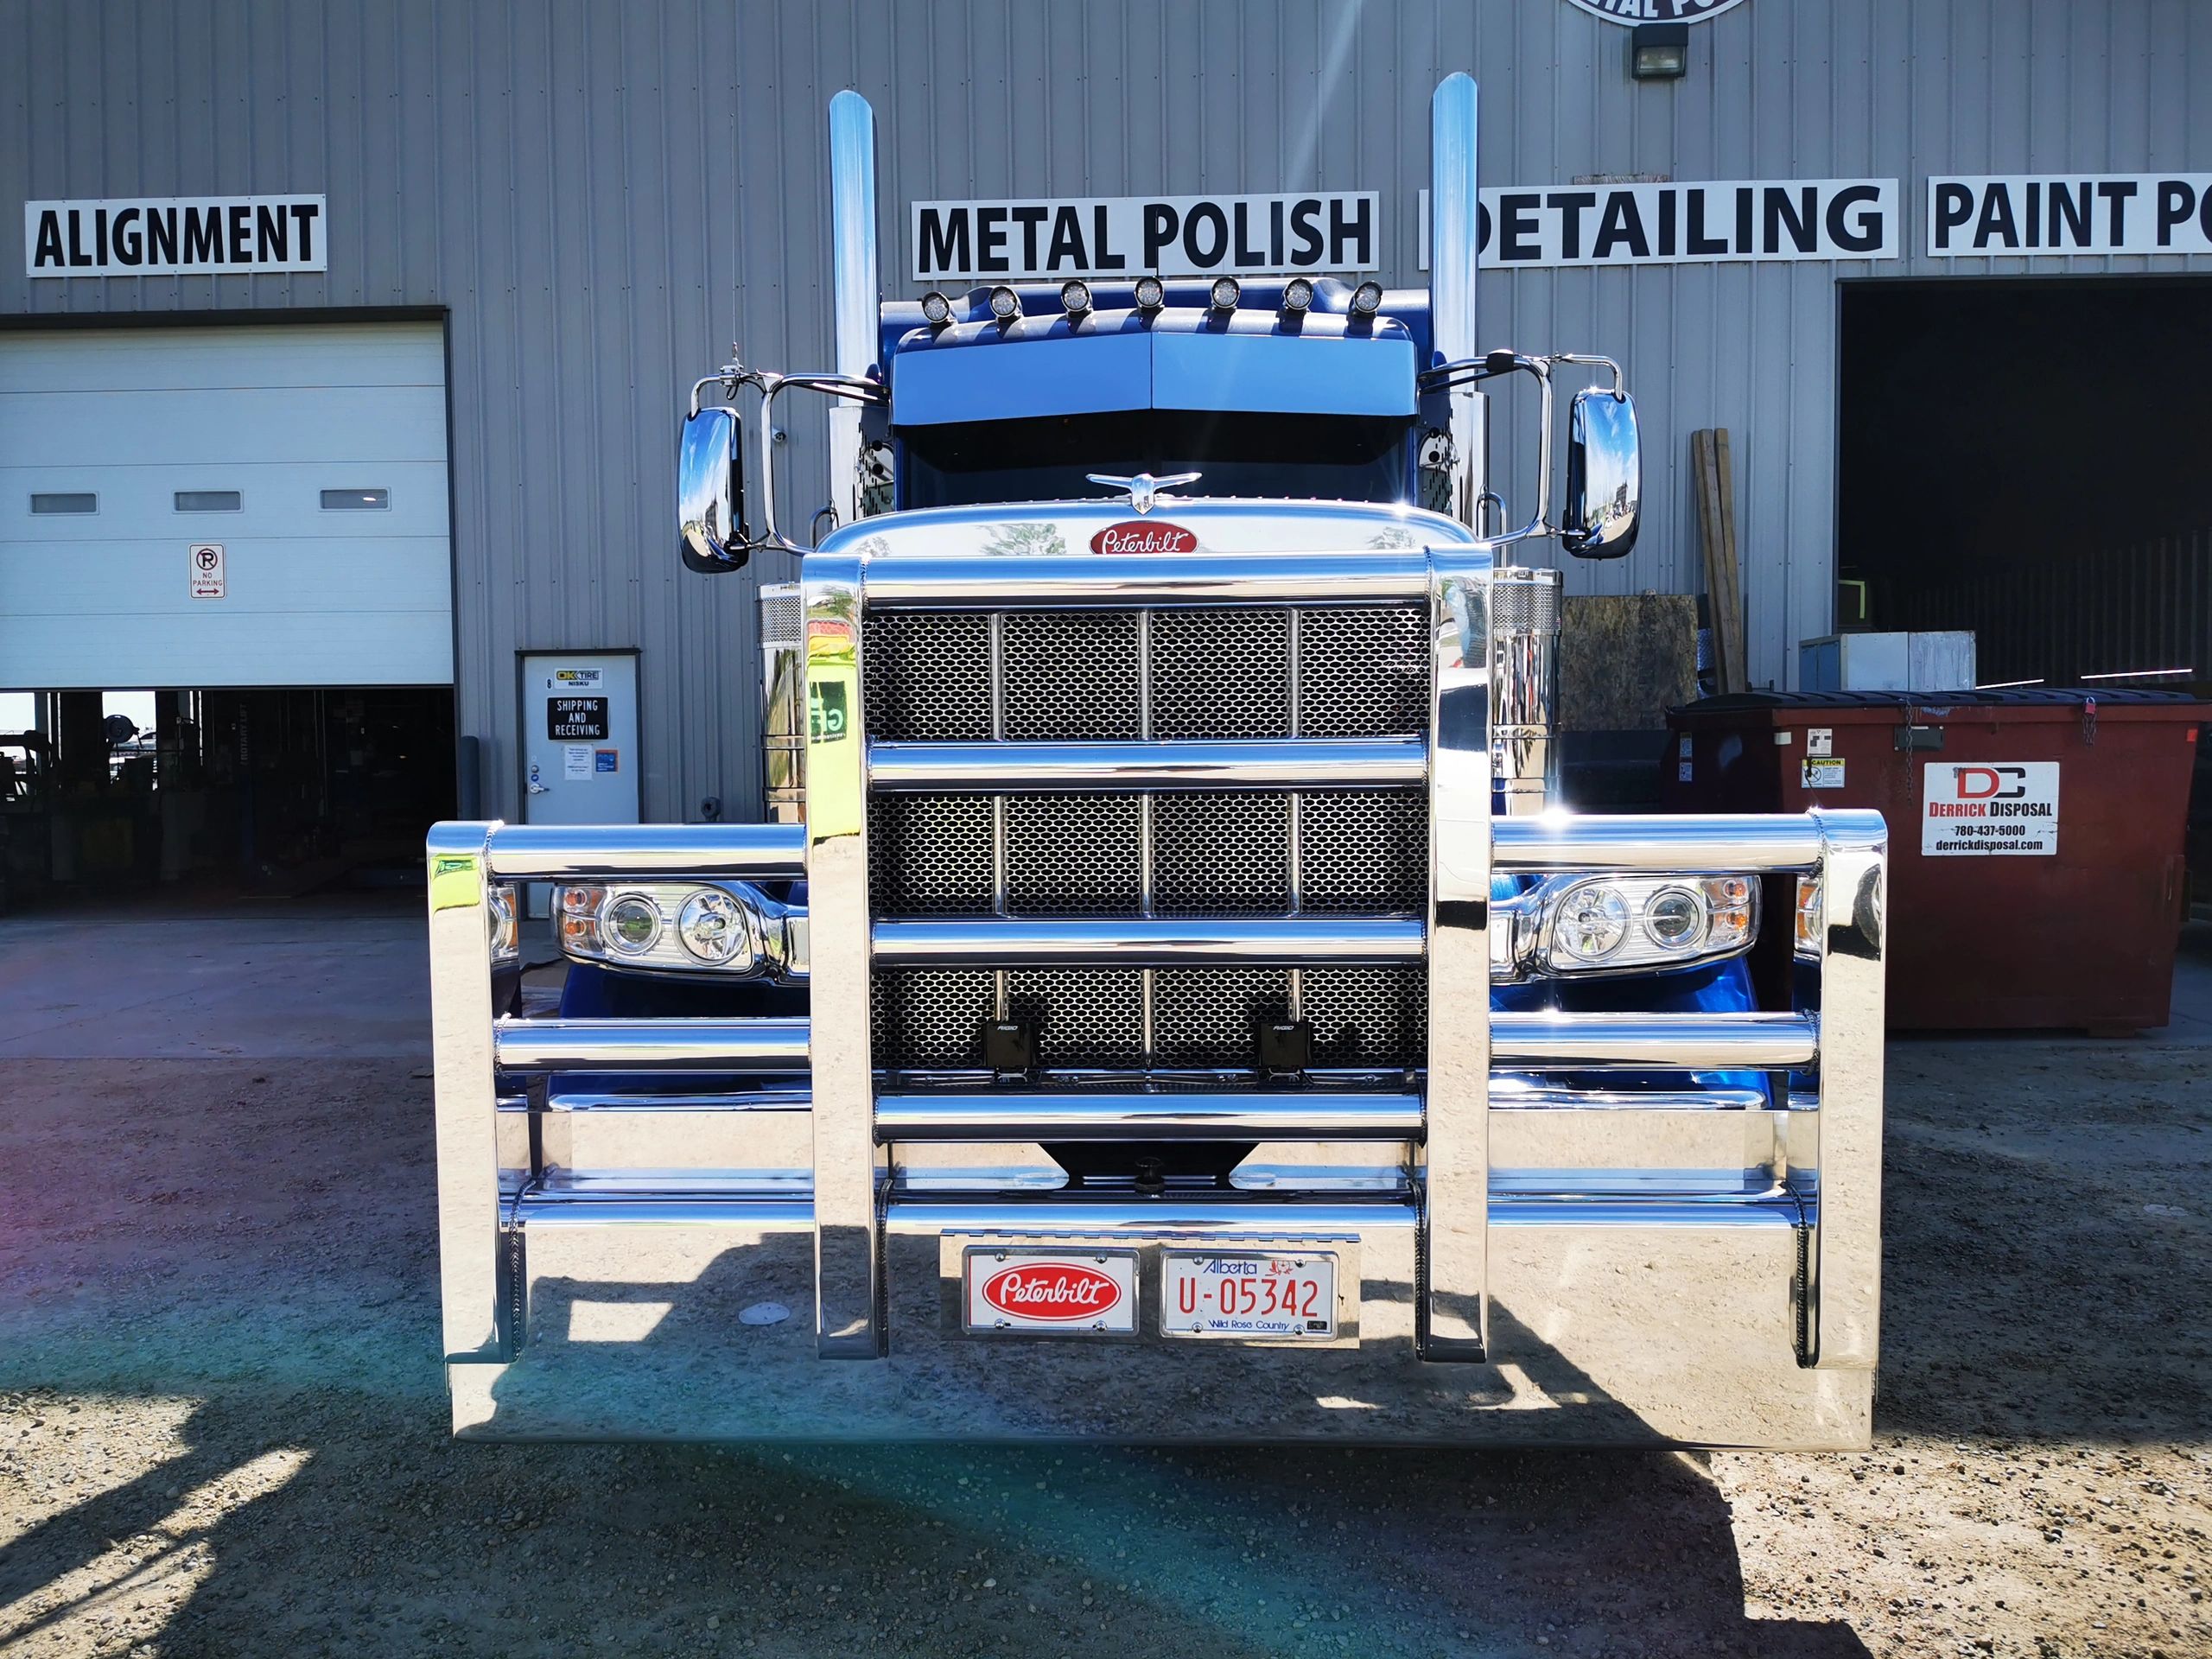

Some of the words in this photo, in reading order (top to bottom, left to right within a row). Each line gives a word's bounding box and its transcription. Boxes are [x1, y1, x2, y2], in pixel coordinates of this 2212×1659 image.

[1935, 181, 2139, 249] PAINT
[1478, 185, 1884, 261] ETAILING
[34, 204, 319, 267] ALIGNMENT
[918, 205, 1126, 273] METAL
[1142, 199, 1371, 269] POLISH
[1102, 530, 1189, 554] Peterbilt
[557, 671, 576, 680] OK
[556, 700, 598, 711] SHIPPING
[569, 712, 586, 723] AND
[555, 724, 601, 735] RECEIVING
[1929, 802, 1986, 817] DERRICK
[1990, 802, 2052, 817] DISPOSAL
[1955, 825, 2025, 836] 780-437-5000
[1936, 840, 2043, 853] derrickdisposal.com
[1203, 1259, 1257, 1274] Alberta
[1000, 1273, 1109, 1306] Peterbilt
[1179, 1277, 1319, 1318] U-05342
[1208, 1319, 1228, 1328] Wild
[1256, 1320, 1290, 1331] Country
